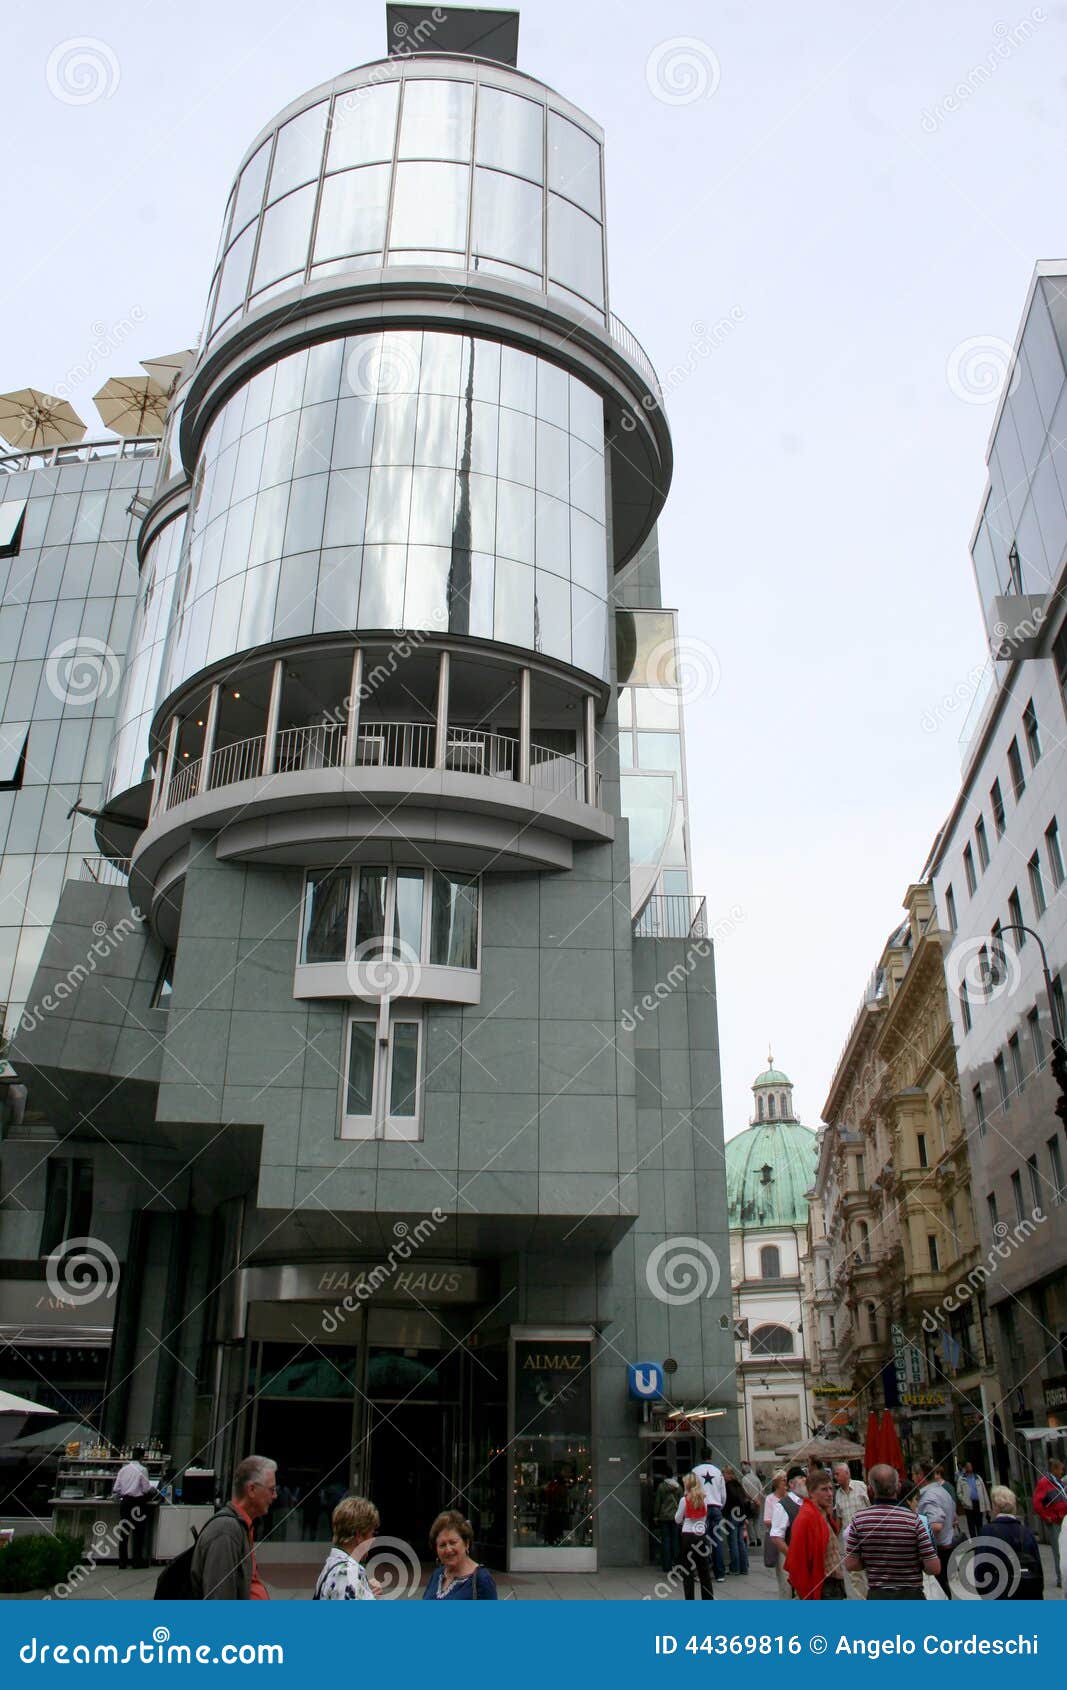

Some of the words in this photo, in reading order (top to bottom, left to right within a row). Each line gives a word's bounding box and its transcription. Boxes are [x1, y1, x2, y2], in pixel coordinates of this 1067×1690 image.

[318, 1271, 383, 1291] HAA
[393, 1271, 462, 1292] HAUS
[523, 1354, 582, 1370] ALMAZ
[635, 1369, 658, 1394] U
